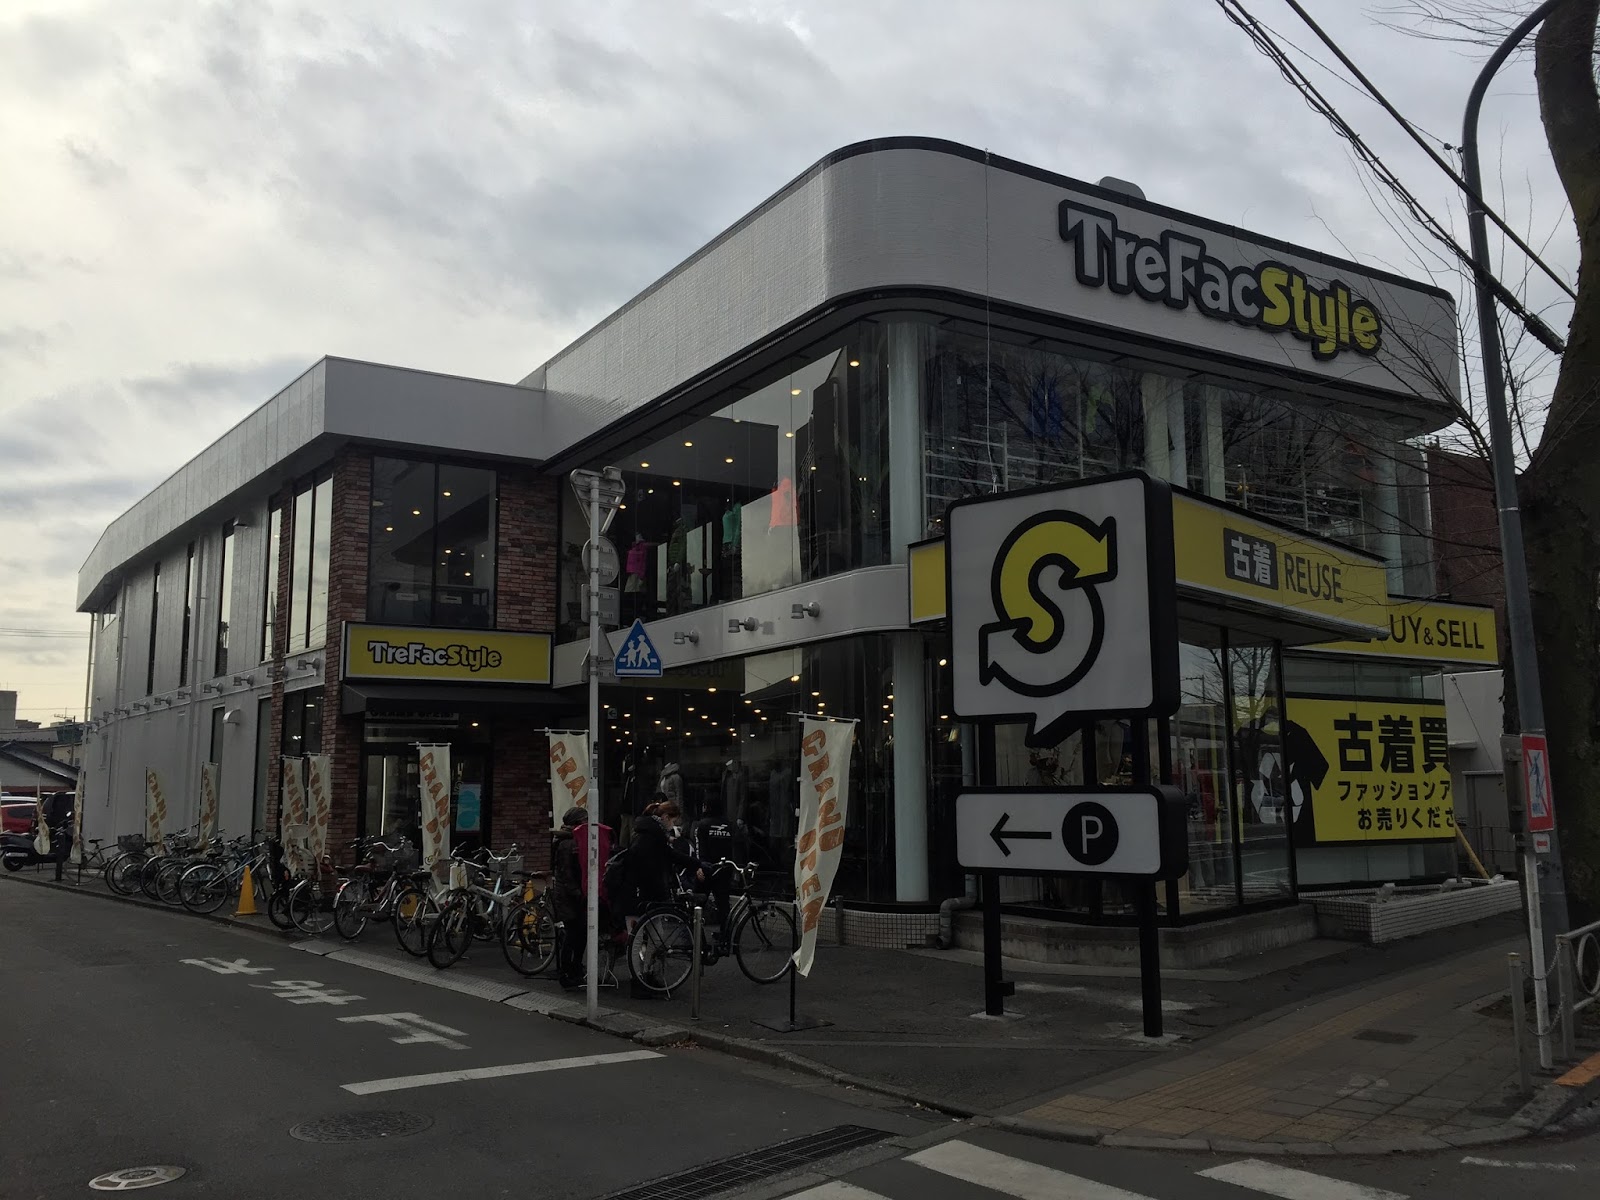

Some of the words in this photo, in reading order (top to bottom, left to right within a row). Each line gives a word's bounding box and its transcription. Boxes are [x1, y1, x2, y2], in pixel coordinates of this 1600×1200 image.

[1060, 200, 1381, 360] TreFacStyle
[1230, 535, 1273, 586] 古着
[1284, 552, 1344, 604] REUSE
[367, 640, 502, 672] TreFacStyle
[1376, 613, 1485, 650] UY&SELL
[1333, 712, 1451, 775] 古着買
[803, 729, 845, 852] GRAND
[1337, 779, 1451, 803] ファッションア
[1080, 815, 1104, 854] P
[800, 828, 825, 934] OPEN
